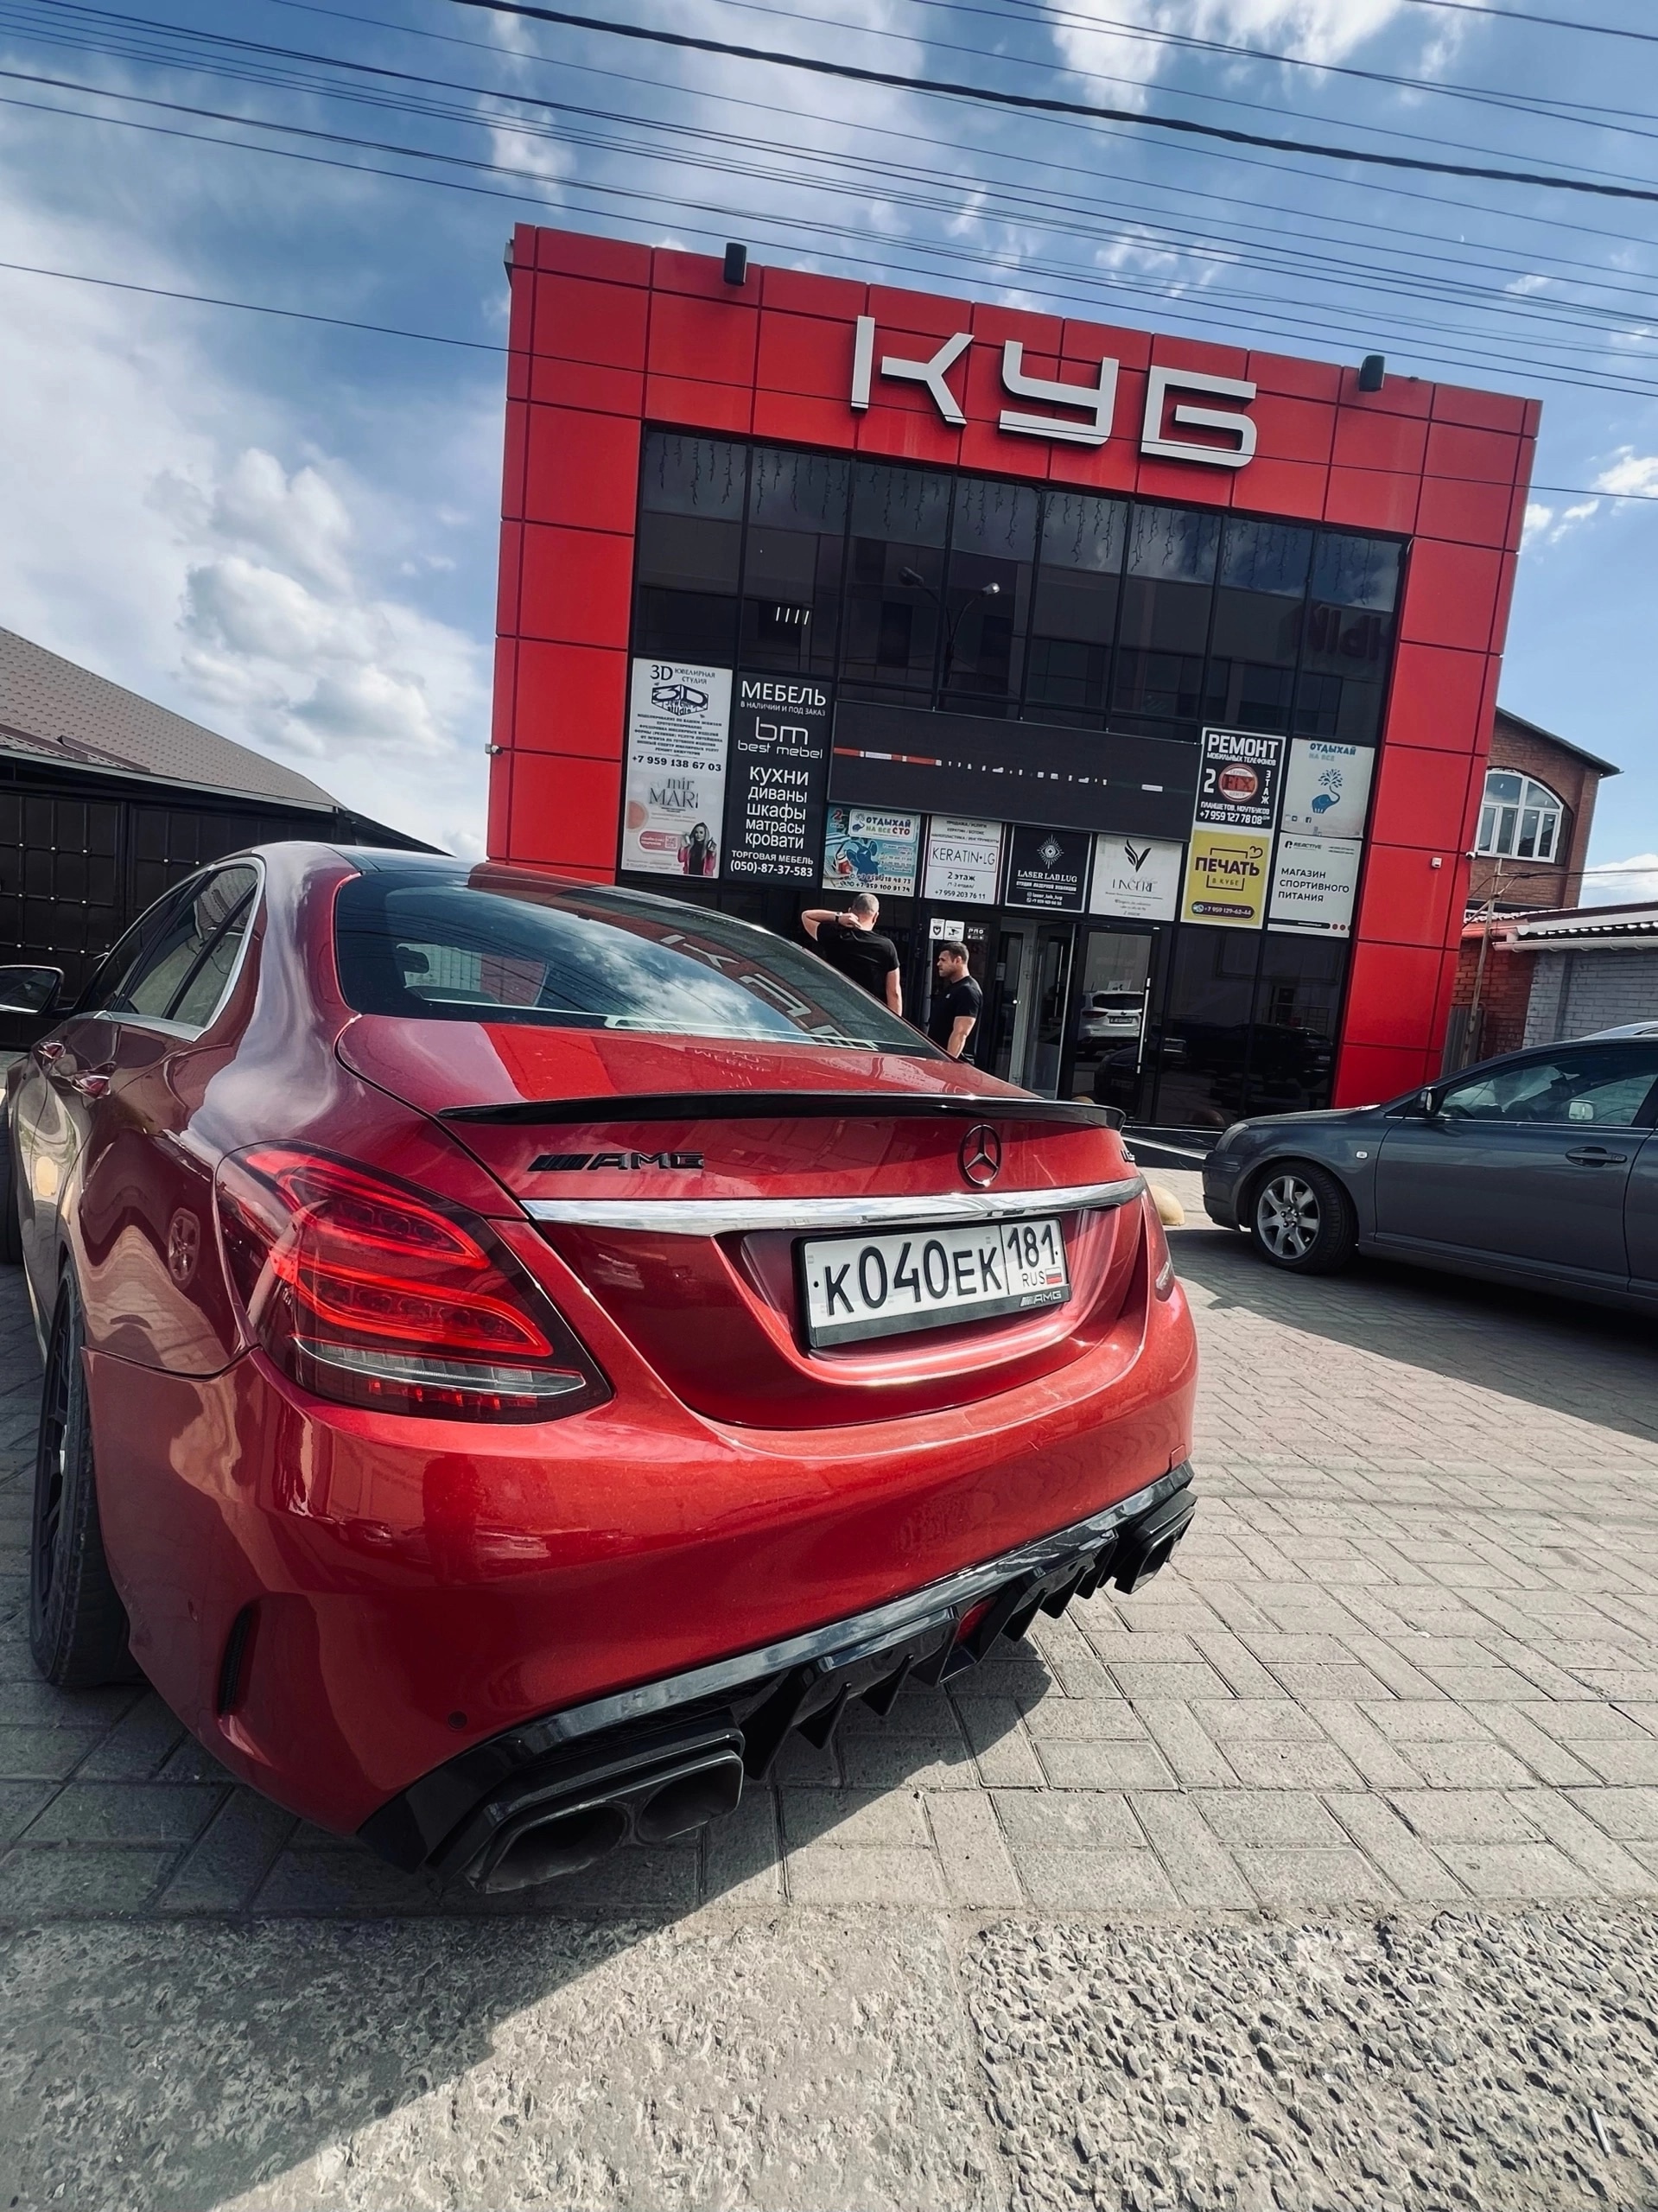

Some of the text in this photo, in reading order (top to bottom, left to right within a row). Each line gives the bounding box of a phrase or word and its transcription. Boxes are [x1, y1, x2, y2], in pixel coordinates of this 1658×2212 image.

[851, 315, 1257, 468] КУБ
[650, 664, 673, 681] 3D
[675, 667, 715, 678] ЮВЕЛИРНАЯ
[682, 676, 707, 684] СТУДИЯ
[741, 680, 826, 706] МЕБЕЛЬ
[746, 702, 780, 712] НАЛИЧИИ
[788, 707, 804, 715] ПОД
[804, 708, 826, 716] ЗАКАЗ
[755, 716, 809, 745] bm
[738, 740, 823, 759] best mebel
[1208, 734, 1279, 759] РЕМОНТ
[1310, 742, 1356, 755] ОТДЫХАЙ
[647, 756, 667, 766] 959
[670, 759, 689, 768] 138
[692, 761, 705, 770] 67
[708, 763, 721, 772] 03
[1207, 752, 1276, 766] МОБИЛЬНЫХ ТЕЛЕФОНОВ
[667, 777, 695, 791] mir
[749, 766, 810, 786] кухни
[1204, 768, 1217, 793] 2
[748, 786, 808, 804] диваны
[746, 803, 806, 823] шкафы
[832, 809, 843, 822] 2
[1201, 801, 1270, 815] ПЛАНШЕТОВ, НОУТБУКОВ
[866, 817, 912, 828] ОТДЫХАЙ
[1199, 810, 1210, 819] +7
[1210, 810, 1226, 821] 959
[1227, 812, 1240, 823] 127
[1241, 814, 1250, 823] 78
[1252, 815, 1262, 824] 08
[746, 818, 805, 835] матрасы
[745, 832, 804, 849] кровати
[732, 850, 814, 865] ТОРГОВАЯ МЕБЕЛЬ
[730, 860, 813, 877] (050)-87-37-583
[1195, 856, 1260, 877] ПЕЧАТЬ
[1281, 868, 1326, 879] МАГАЗИН
[1017, 870, 1044, 879] LASER
[1061, 874, 1077, 883] LUG
[1280, 880, 1350, 893] СПОРТИВНОГО
[1278, 891, 1324, 902] ПИТАНИЯ
[588, 1152, 704, 1170] AMG
[1007, 1224, 1055, 1269] 181
[1021, 1270, 1045, 1287] RUS
[1034, 1290, 1062, 1305] AMG
